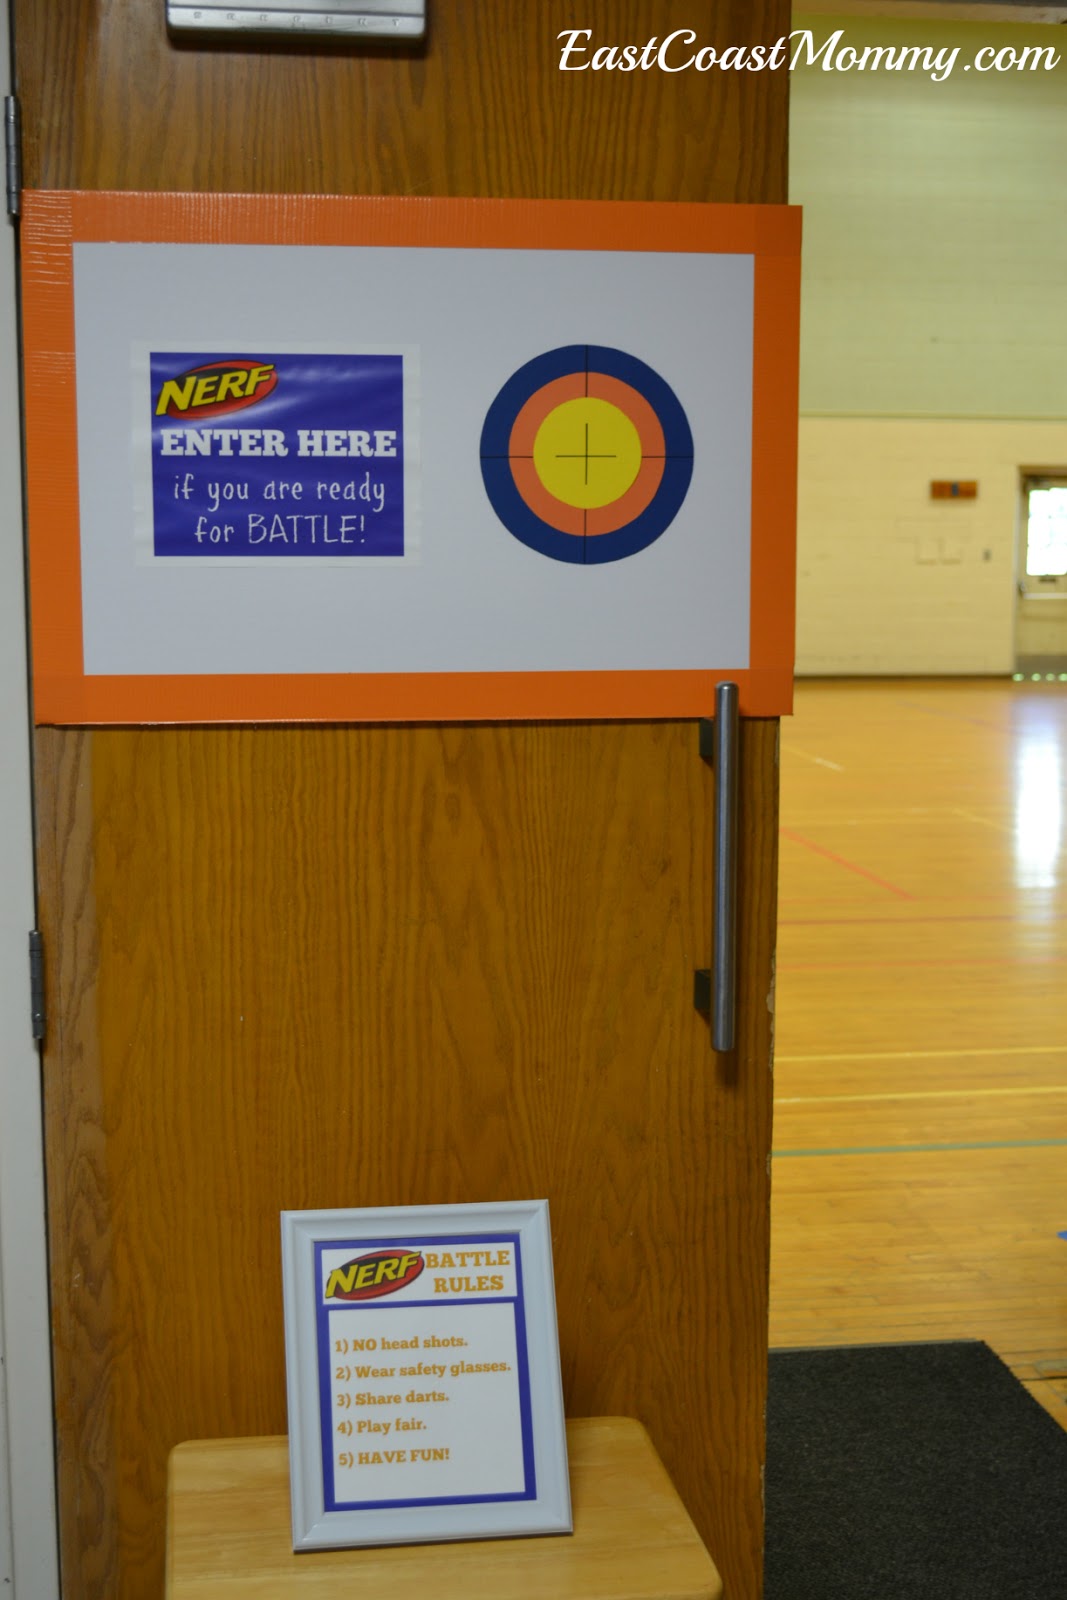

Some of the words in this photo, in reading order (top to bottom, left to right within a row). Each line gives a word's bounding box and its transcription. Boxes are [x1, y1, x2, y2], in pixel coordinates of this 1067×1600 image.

[155, 364, 275, 416] NERF
[160, 429, 288, 456] ENTER
[297, 430, 397, 457] HERE
[174, 473, 194, 500] if
[208, 481, 249, 512] you
[263, 480, 303, 500] are
[317, 472, 385, 512] ready
[195, 516, 235, 543] for
[248, 514, 366, 544] BATTLE!
[325, 1251, 422, 1299] NERF
[425, 1250, 511, 1269] BATTLE
[434, 1275, 504, 1294] RULES
[335, 1339, 349, 1354] 1)
[353, 1338, 377, 1352] NO
[381, 1336, 420, 1351] head
[423, 1335, 468, 1349] shots.
[335, 1366, 351, 1382] 2)
[355, 1365, 395, 1379] Wear
[399, 1362, 446, 1379] safety
[450, 1360, 511, 1377] glasses.
[336, 1393, 351, 1408] 3)
[355, 1391, 402, 1407] Share
[405, 1389, 449, 1404] darts.
[336, 1420, 353, 1436] 4)
[357, 1419, 391, 1435] Play
[395, 1417, 427, 1432] fair.
[338, 1452, 354, 1469] 5)
[358, 1450, 406, 1466] HAVE
[410, 1448, 450, 1463] FUN!
